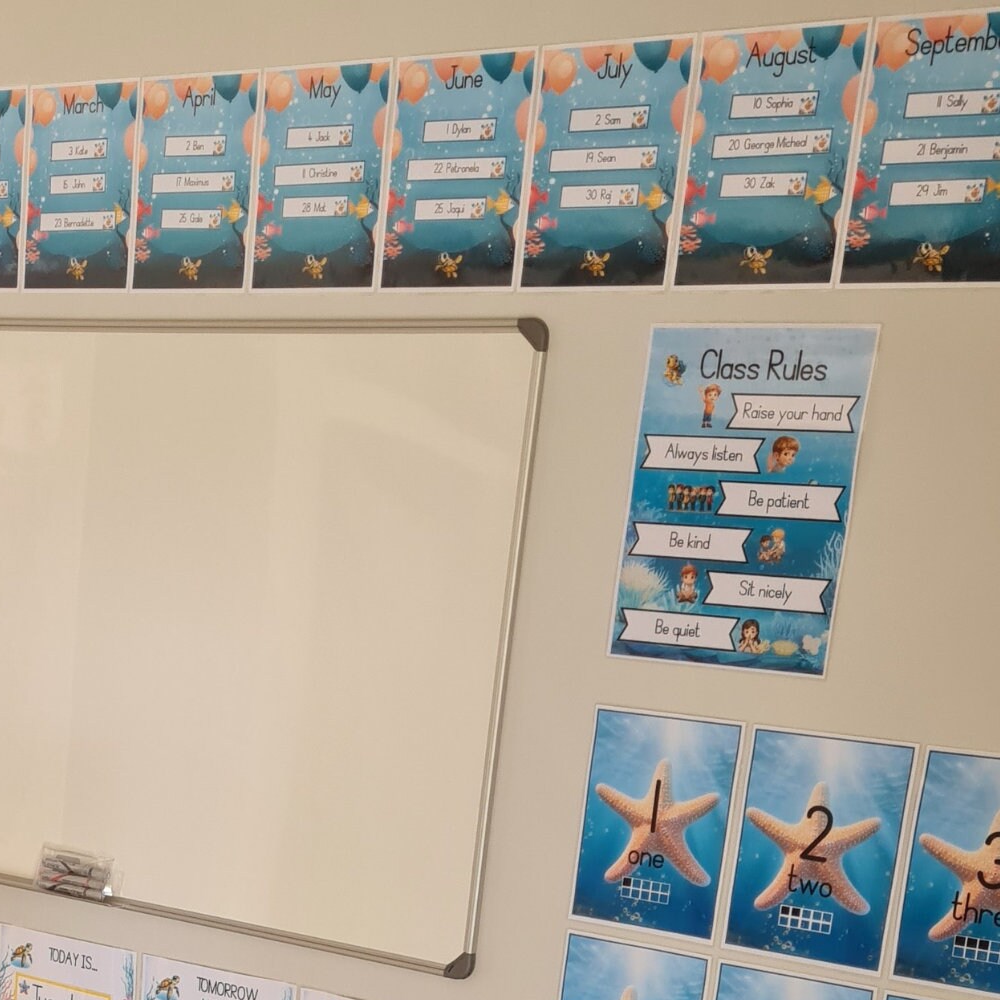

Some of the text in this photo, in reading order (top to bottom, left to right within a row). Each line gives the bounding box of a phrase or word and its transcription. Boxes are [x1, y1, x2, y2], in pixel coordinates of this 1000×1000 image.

[745, 36, 818, 77] August
[905, 23, 1000, 66] Septemb
[445, 65, 483, 90] June
[597, 52, 633, 88] July
[182, 86, 217, 117] April
[309, 76, 341, 108] May
[947, 95, 968, 112] Sally
[63, 94, 104, 115] March
[765, 97, 793, 113] Sophia
[744, 138, 775, 154] George
[930, 143, 968, 160] Benjamin
[700, 348, 828, 381] Class Rules
[742, 402, 843, 426] Raise your hand
[665, 444, 743, 466] Always listen
[748, 490, 810, 513] Be patient
[669, 531, 711, 550] Be kind
[739, 580, 792, 605] Sit nicely
[655, 618, 700, 641] Be quiet
[650, 779, 662, 833] 1
[800, 805, 833, 862] 2
[628, 848, 665, 869] one
[788, 863, 832, 898] two
[48, 946, 78, 968] TODAY
